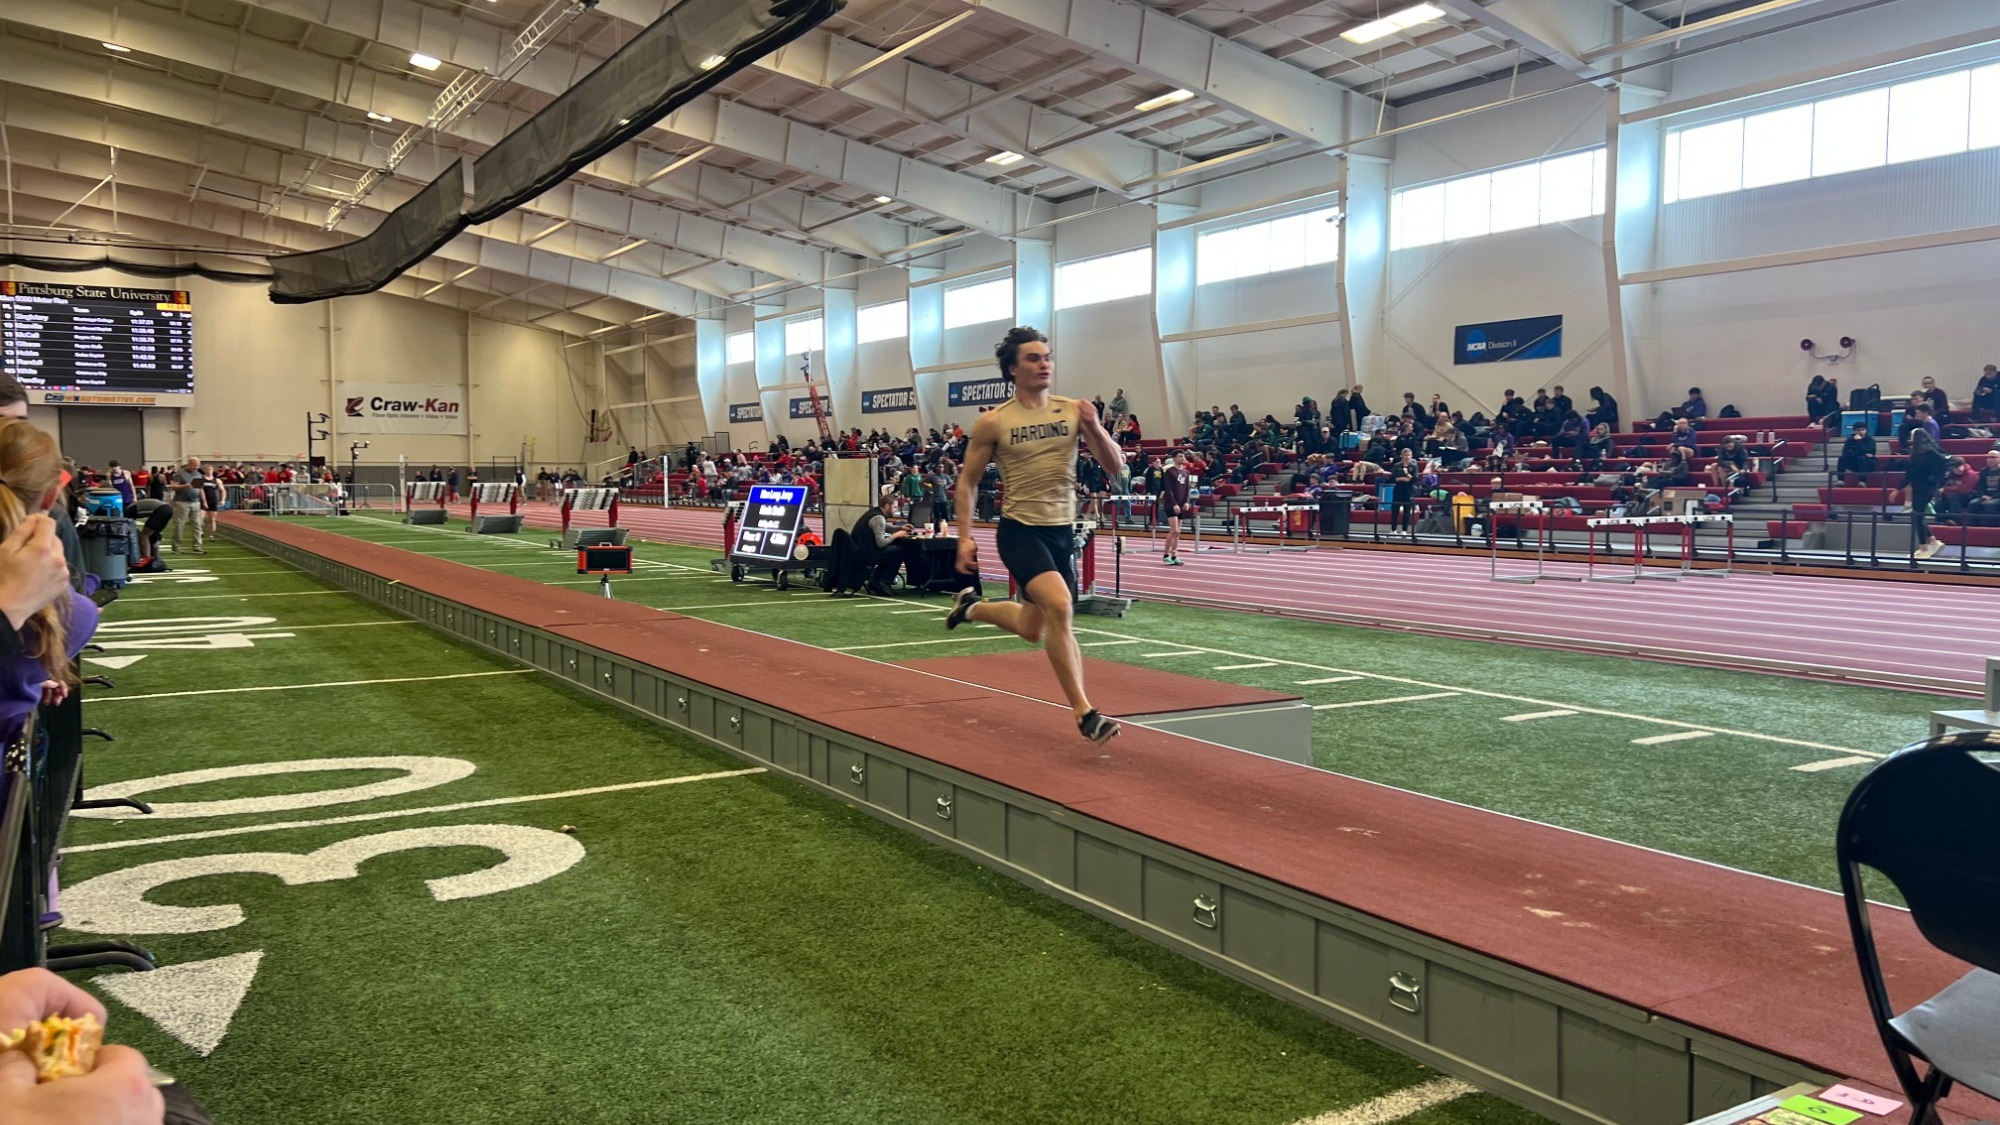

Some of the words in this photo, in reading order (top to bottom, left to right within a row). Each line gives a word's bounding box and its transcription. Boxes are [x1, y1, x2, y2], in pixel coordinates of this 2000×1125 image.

[18, 282, 74, 298] Pittsburg
[76, 285, 107, 298] State
[110, 287, 171, 302] University
[1466, 342, 1486, 351] NCAA
[1488, 340, 1512, 350] Division
[872, 392, 908, 408] SPECTATOR
[962, 382, 1006, 401] SPECTATOR
[370, 396, 460, 412] Craw-Kan
[1010, 420, 1069, 446] HARDING
